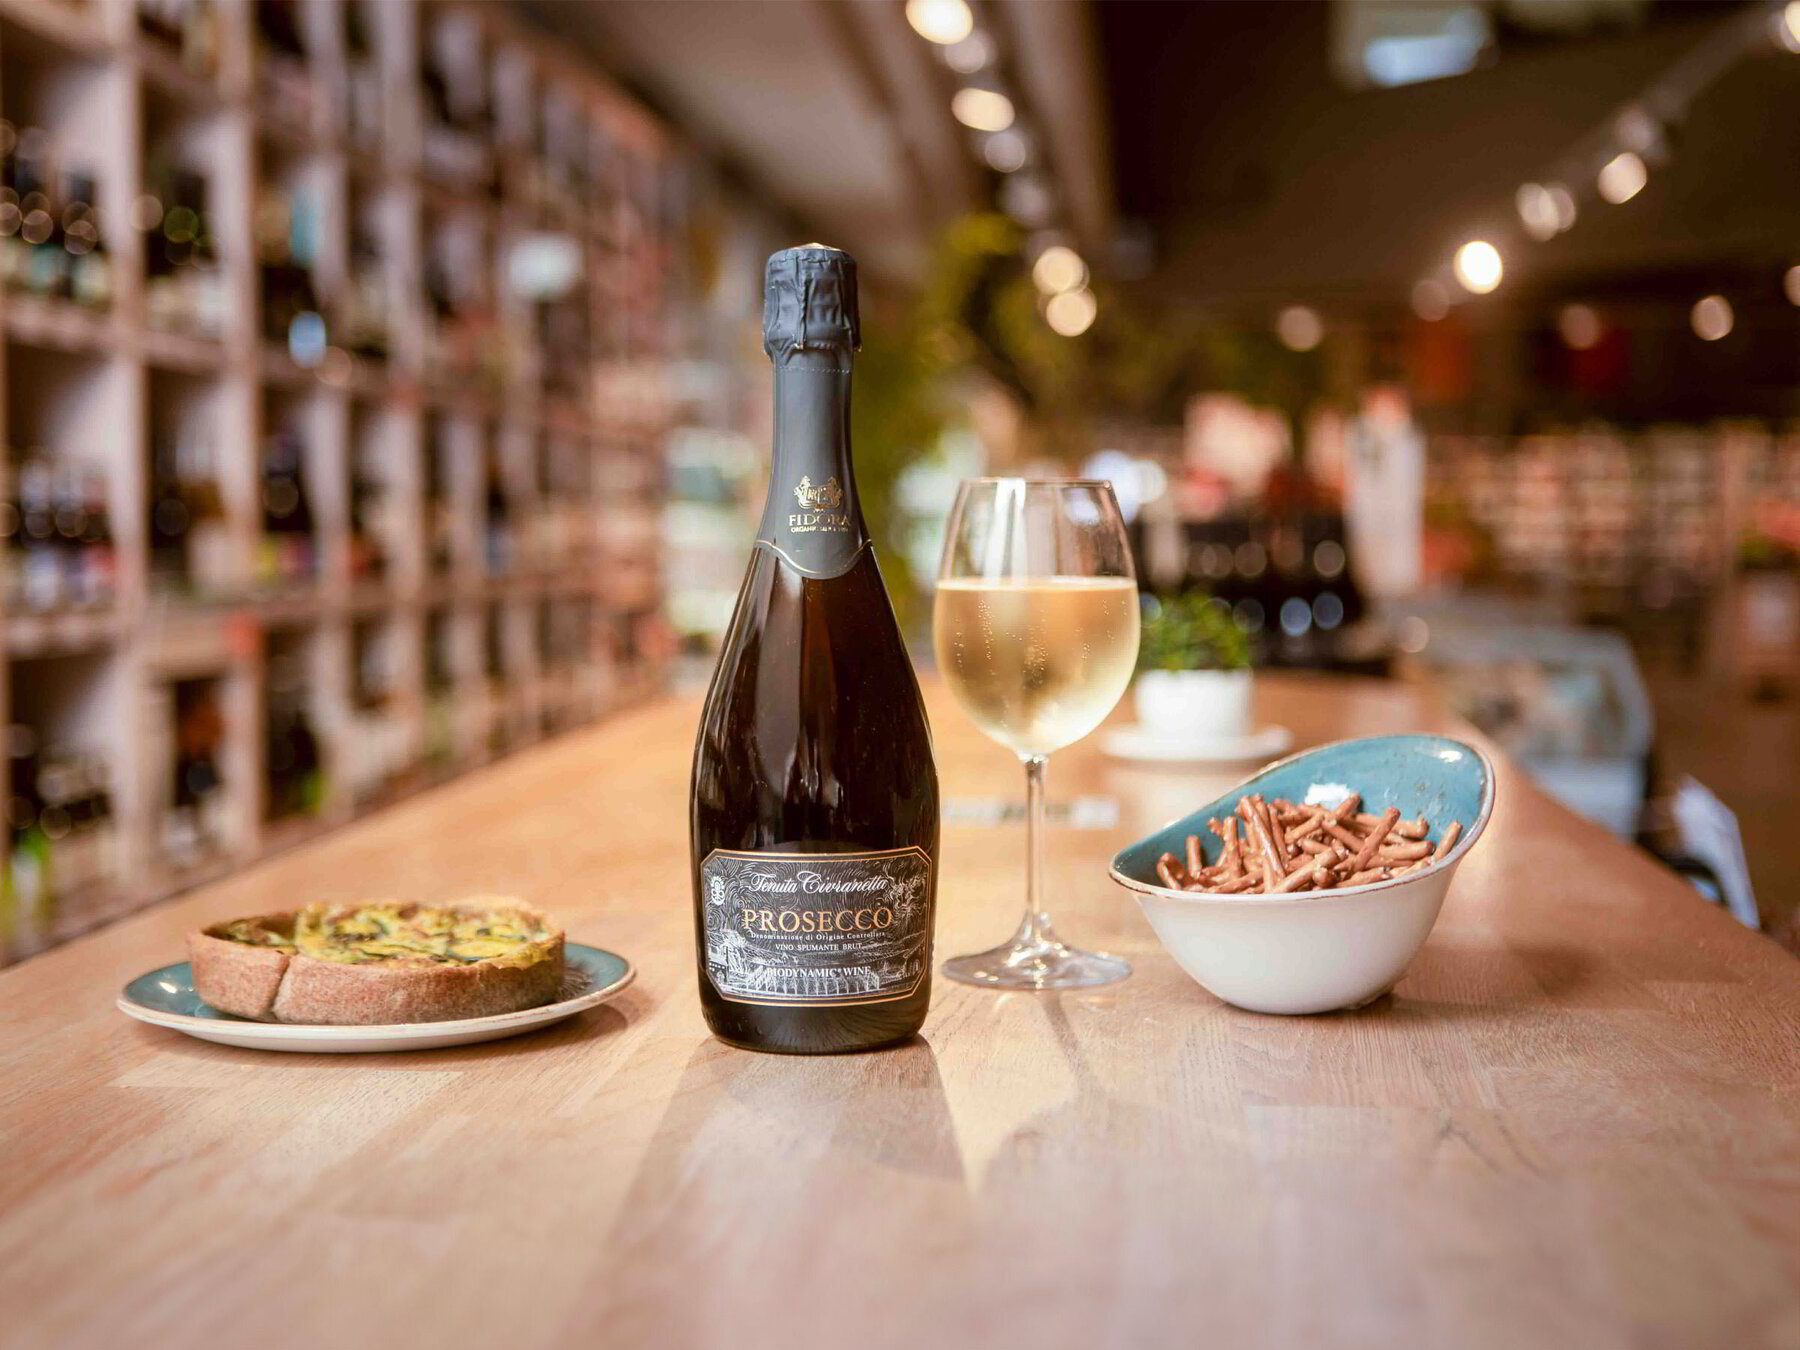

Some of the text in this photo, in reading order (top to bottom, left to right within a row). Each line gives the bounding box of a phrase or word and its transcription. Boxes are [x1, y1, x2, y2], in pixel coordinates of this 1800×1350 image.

[748, 872, 799, 893] Tenuta
[742, 907, 893, 933] PROSECCO
[816, 933, 845, 941] Origine
[775, 943, 795, 951] VINO
[842, 942, 863, 950] BRUT
[842, 966, 872, 976] WINE
